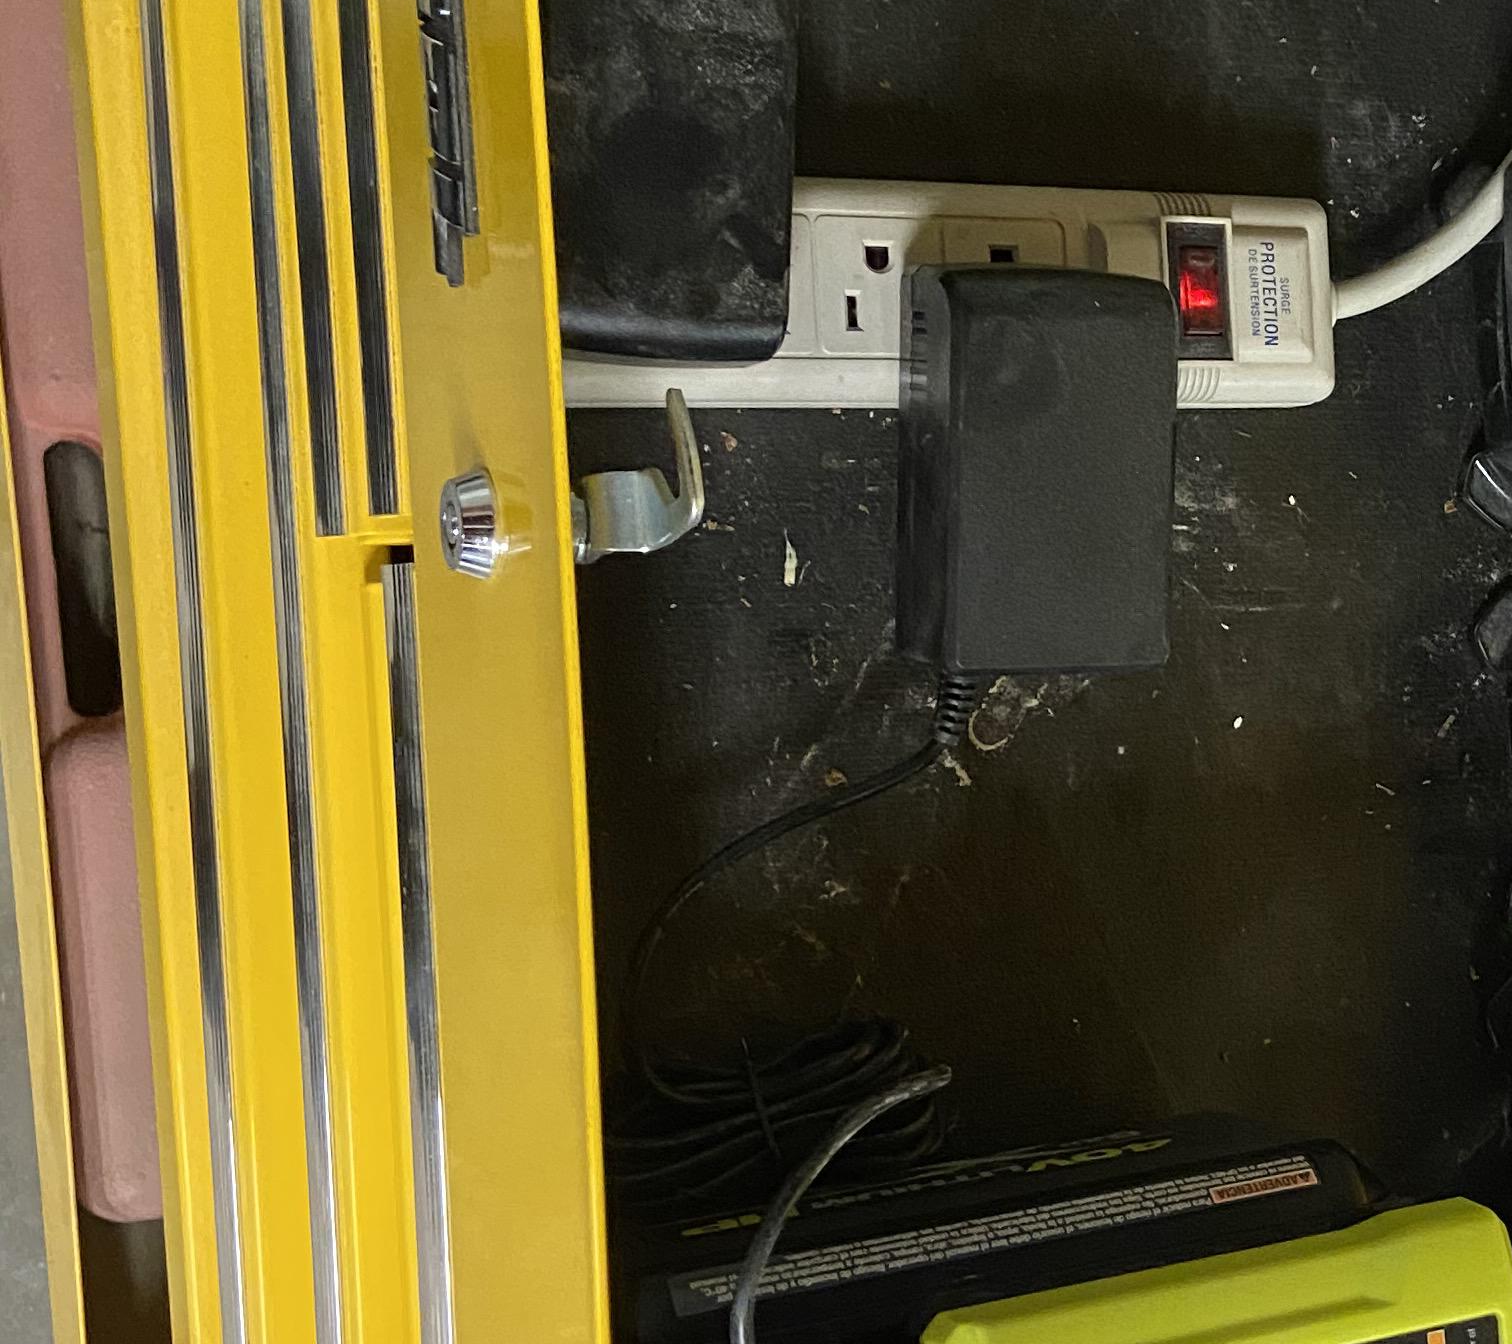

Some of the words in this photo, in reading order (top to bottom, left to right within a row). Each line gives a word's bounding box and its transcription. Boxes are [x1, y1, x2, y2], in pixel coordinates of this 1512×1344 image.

[1248, 249, 1257, 262] DE
[1249, 266, 1260, 336] SURTENSION
[1260, 242, 1278, 345] PROTECTION
[1279, 277, 1290, 314] SURGE
